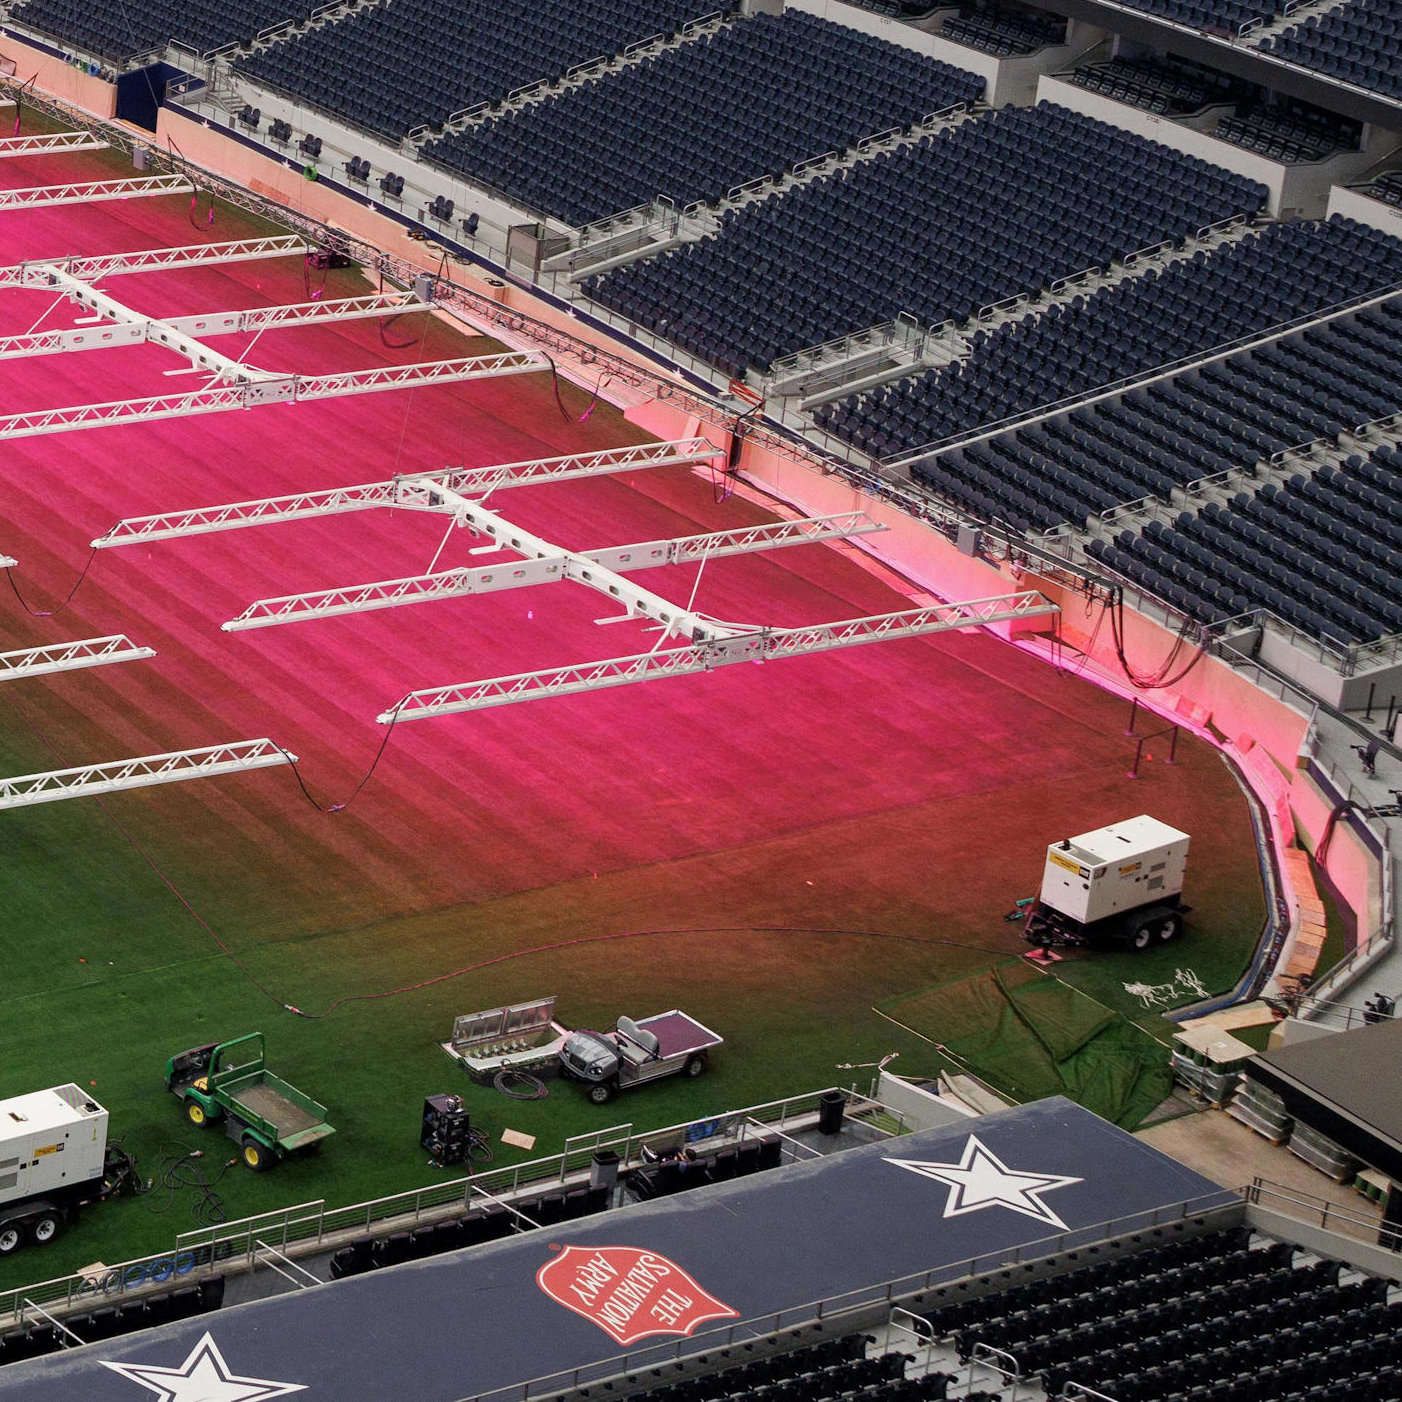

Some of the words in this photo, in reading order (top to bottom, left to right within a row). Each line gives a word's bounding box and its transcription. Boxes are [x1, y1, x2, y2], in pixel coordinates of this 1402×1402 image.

[569, 1252, 619, 1307] ARMY
[596, 1254, 670, 1333] SALVATION
[650, 1288, 693, 1326] THE
